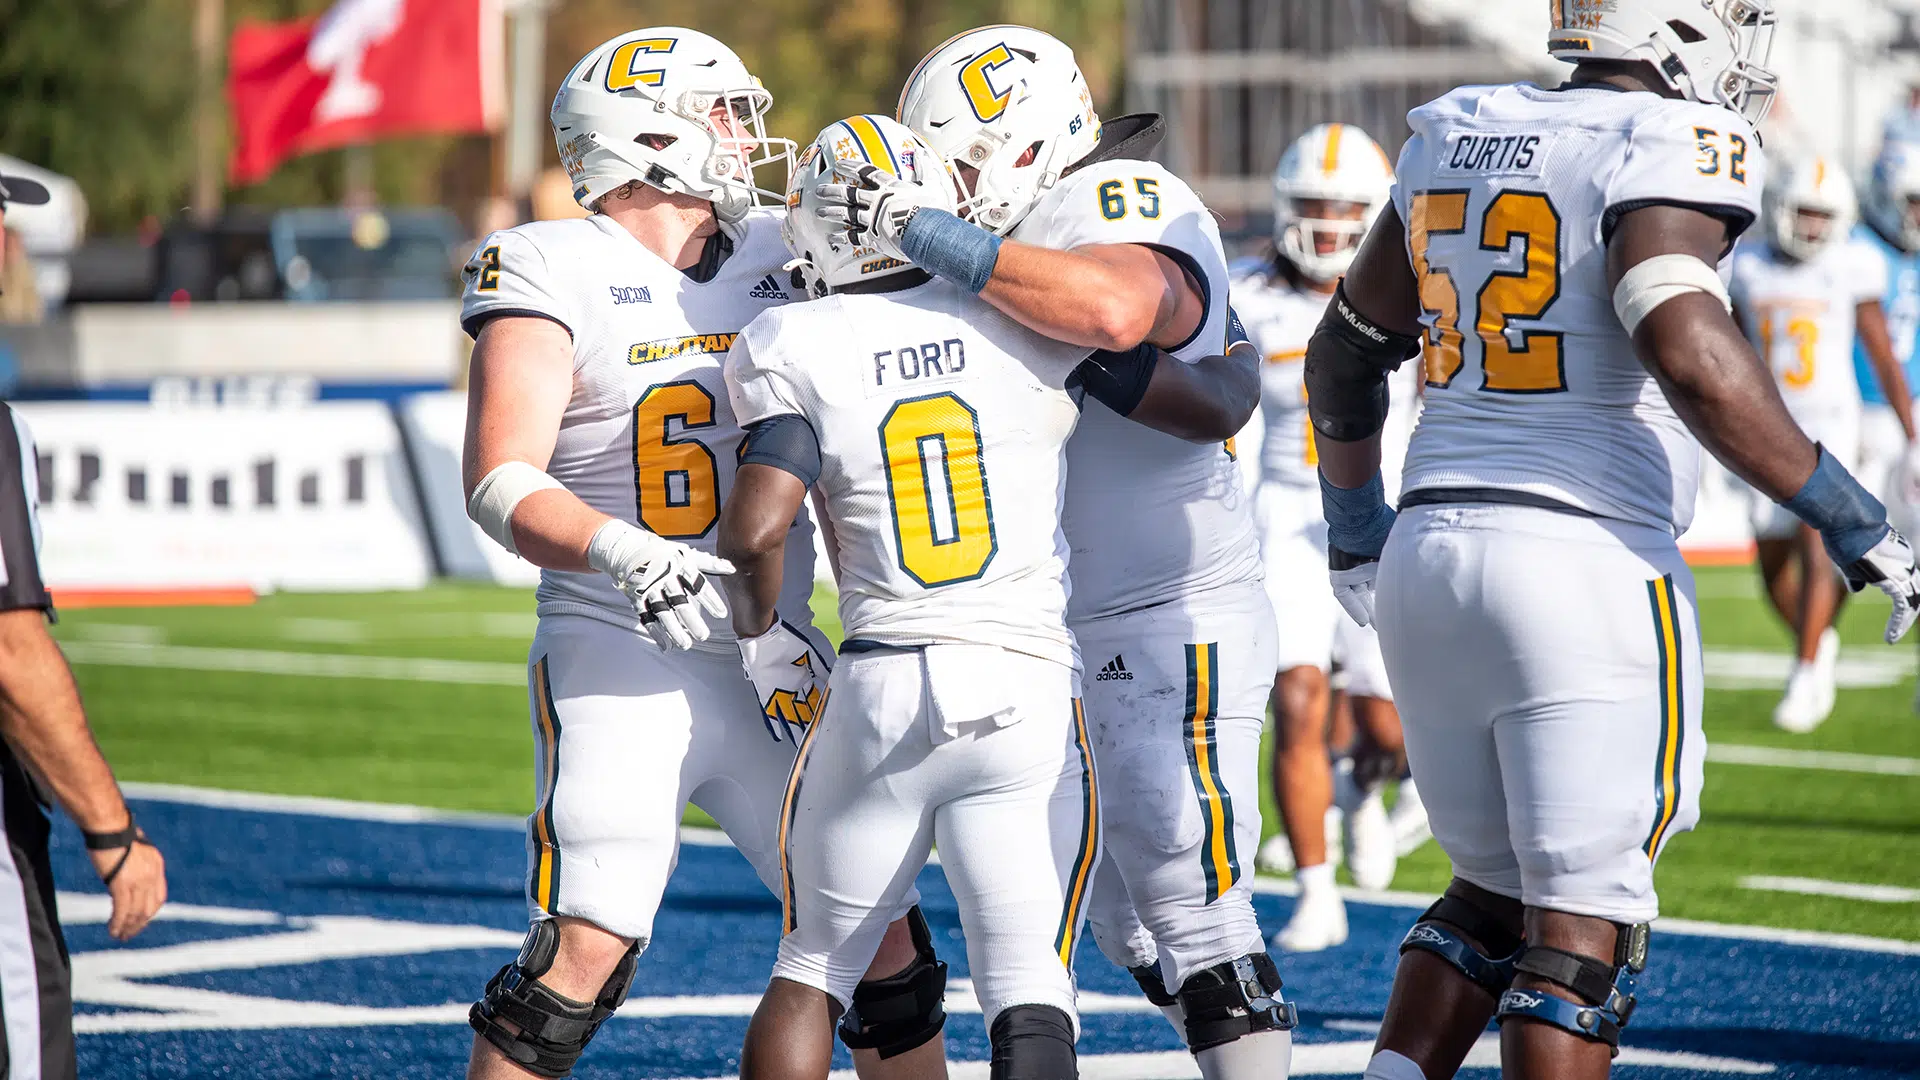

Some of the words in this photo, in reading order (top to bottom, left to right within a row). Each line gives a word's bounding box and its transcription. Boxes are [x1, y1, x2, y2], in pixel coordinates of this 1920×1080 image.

[604, 38, 678, 93] C
[1069, 114, 1083, 136] 65
[1449, 135, 1541, 170] CURTIS
[1692, 126, 1748, 187] 52
[1096, 176, 1162, 222] 65
[470, 244, 501, 292] 2
[1409, 187, 1568, 394] 52
[749, 289, 789, 300] adidas
[627, 332, 740, 365] CHATTAN
[873, 338, 966, 386] FORD
[632, 379, 749, 541] 6
[878, 391, 999, 589] 0
[1095, 670, 1134, 681] adidas
